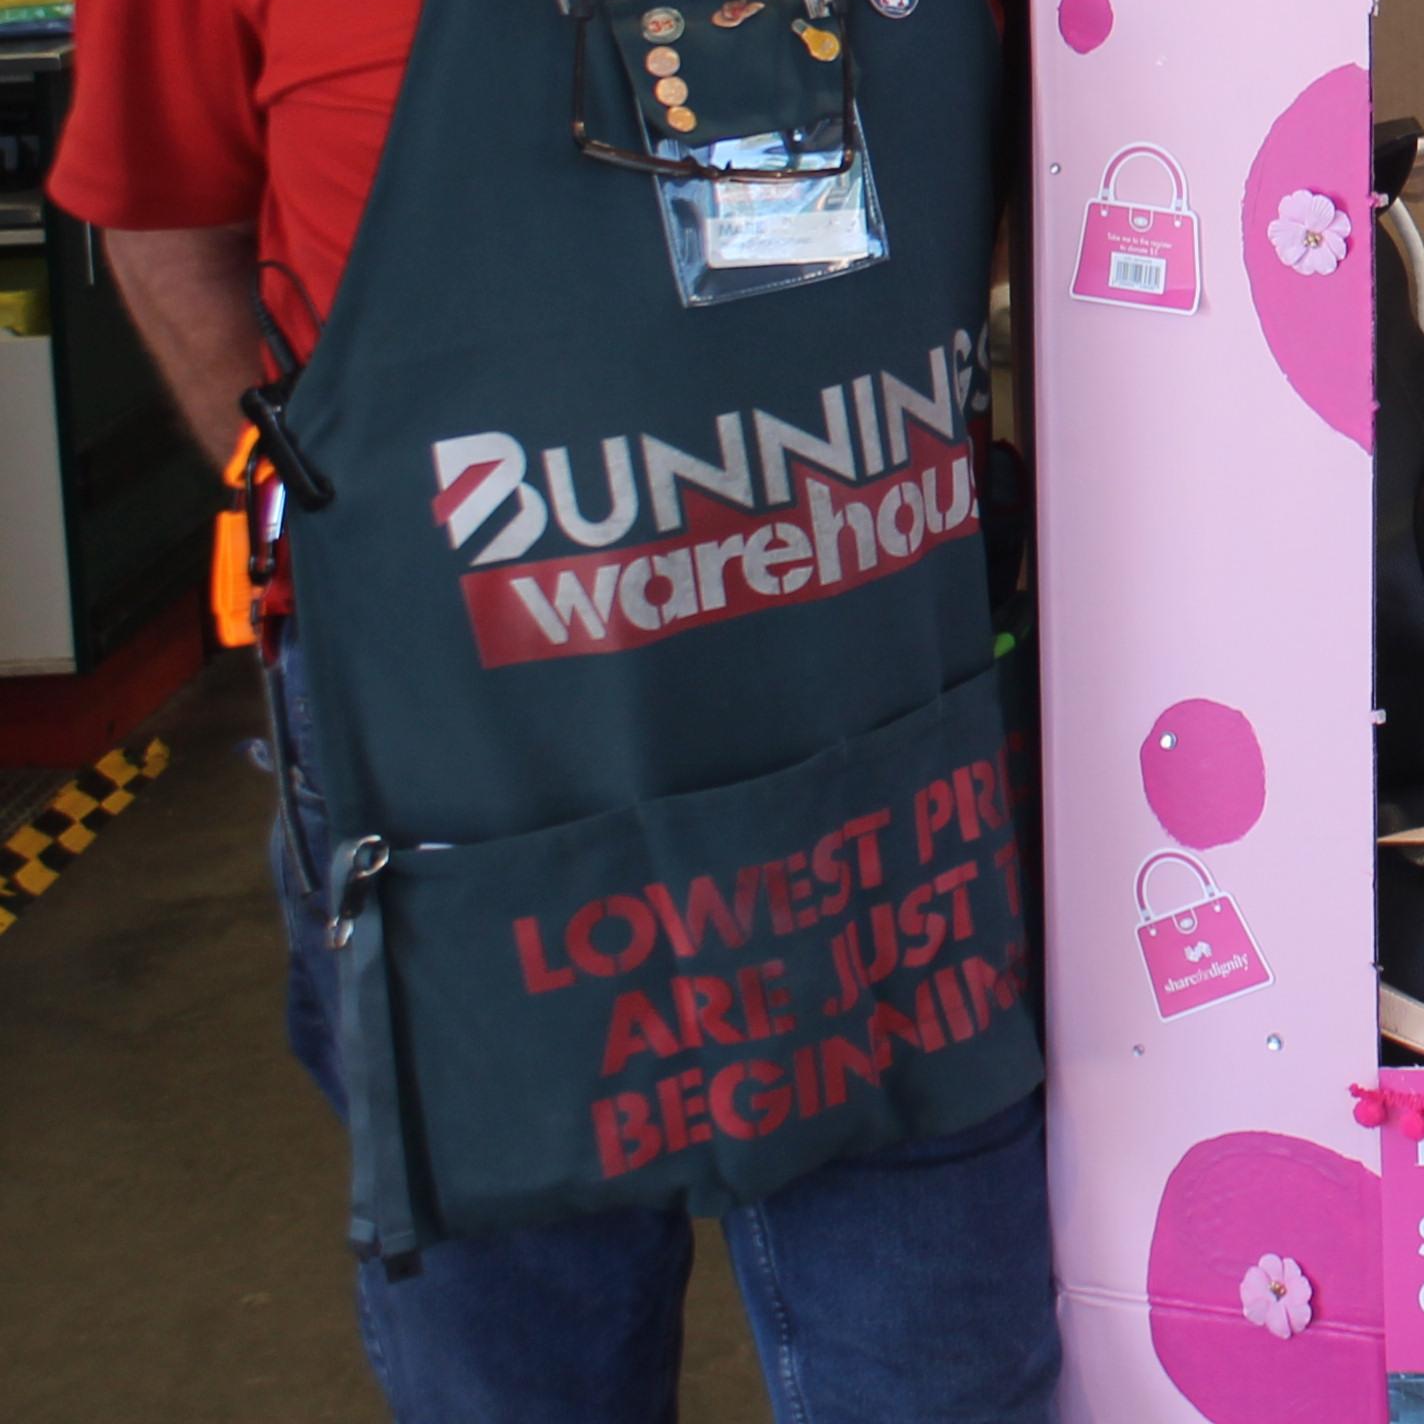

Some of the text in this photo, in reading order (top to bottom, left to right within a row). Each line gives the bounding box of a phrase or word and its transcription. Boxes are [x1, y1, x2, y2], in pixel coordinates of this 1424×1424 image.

[509, 438, 980, 645] warehou
[513, 807, 891, 994] LOWEST
[602, 959, 797, 1077] ARE
[823, 861, 978, 1016] JUST
